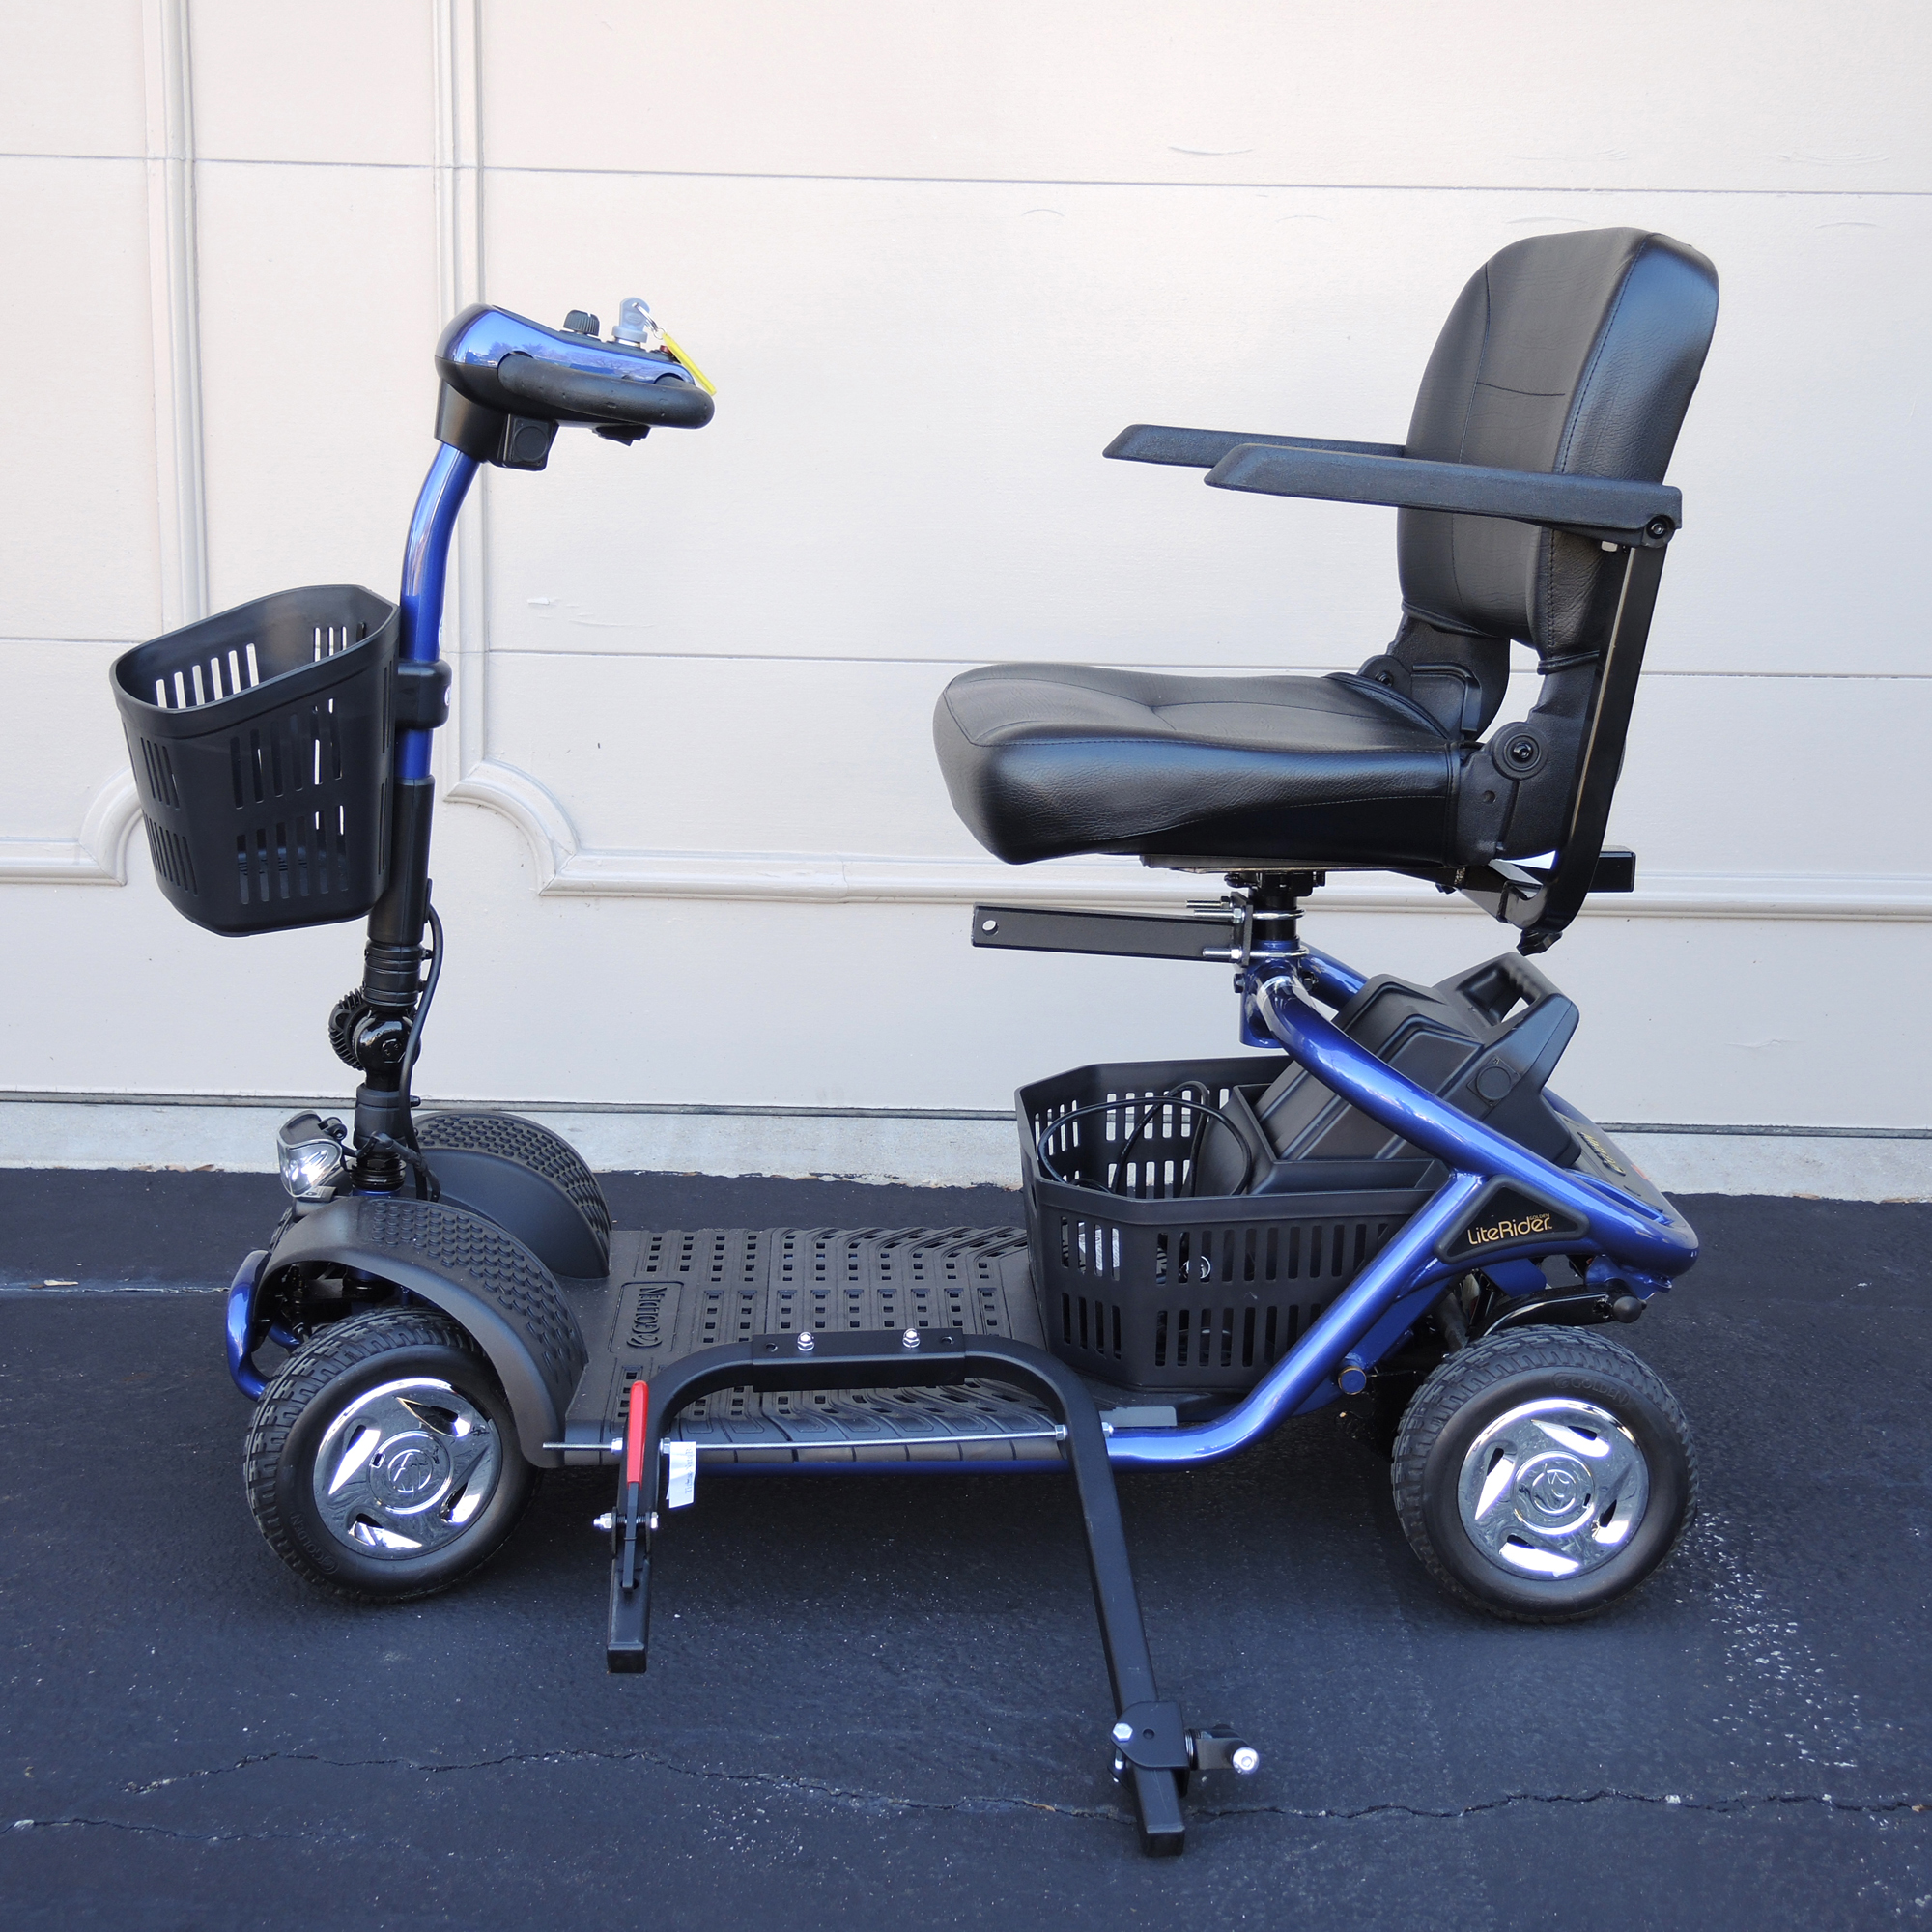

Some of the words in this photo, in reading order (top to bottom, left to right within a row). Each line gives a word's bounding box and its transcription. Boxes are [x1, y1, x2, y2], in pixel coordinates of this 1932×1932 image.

[1467, 1215, 1550, 1245] LiteRider
[632, 1287, 668, 1334] GOLDEN
[1571, 1378, 1628, 1405] GOLDEN
[290, 1513, 324, 1561] GOLDEN
